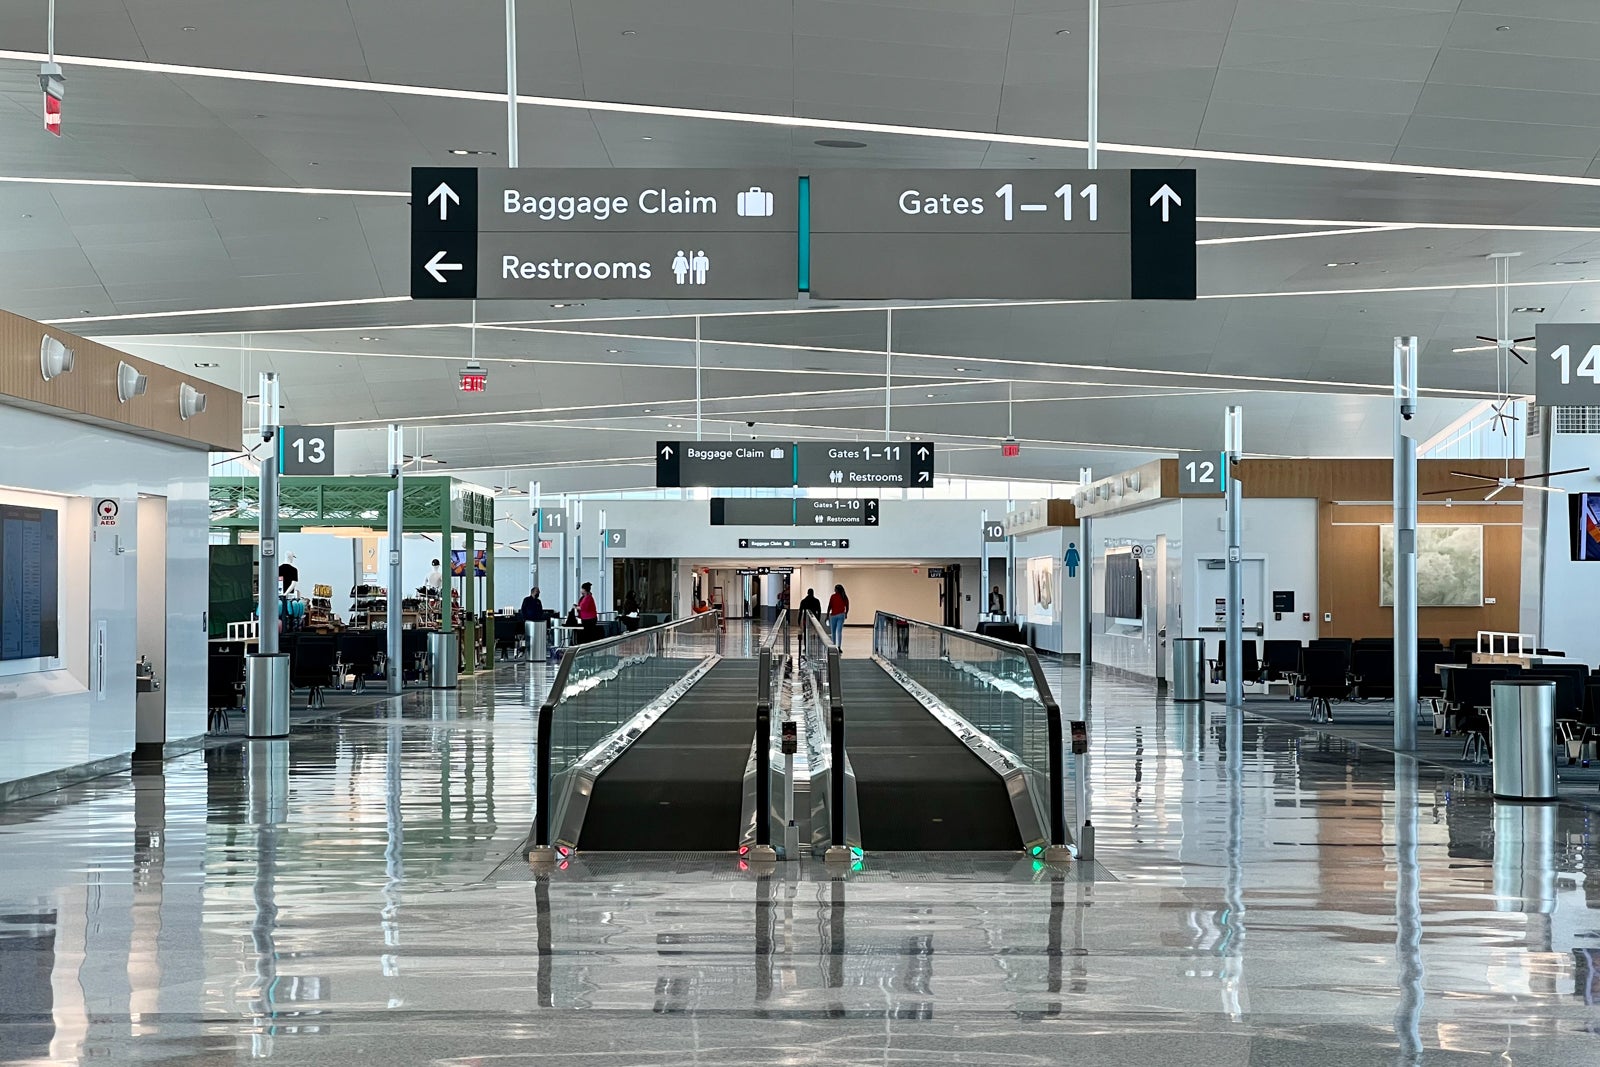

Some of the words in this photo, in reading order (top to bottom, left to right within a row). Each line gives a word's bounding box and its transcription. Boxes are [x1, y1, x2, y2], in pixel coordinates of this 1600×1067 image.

[503, 189, 629, 220] Baggage
[638, 188, 718, 214] Claim
[899, 190, 985, 215] Gates
[995, 183, 1098, 221] 1–11
[502, 255, 652, 280] Restrooms
[1550, 344, 1600, 385] 14
[292, 437, 326, 464] 13
[687, 448, 733, 460] Baggage
[735, 448, 765, 458] Claim
[828, 448, 860, 458] Gates
[862, 446, 900, 461] 1–11
[849, 472, 903, 482] Restrooms
[1185, 461, 1215, 483] 12
[813, 501, 833, 509] Gates
[834, 500, 860, 510] 1–10
[546, 513, 561, 527] 11
[826, 515, 860, 523] Restrooms
[986, 525, 1003, 537] 10
[612, 533, 621, 544] 9
